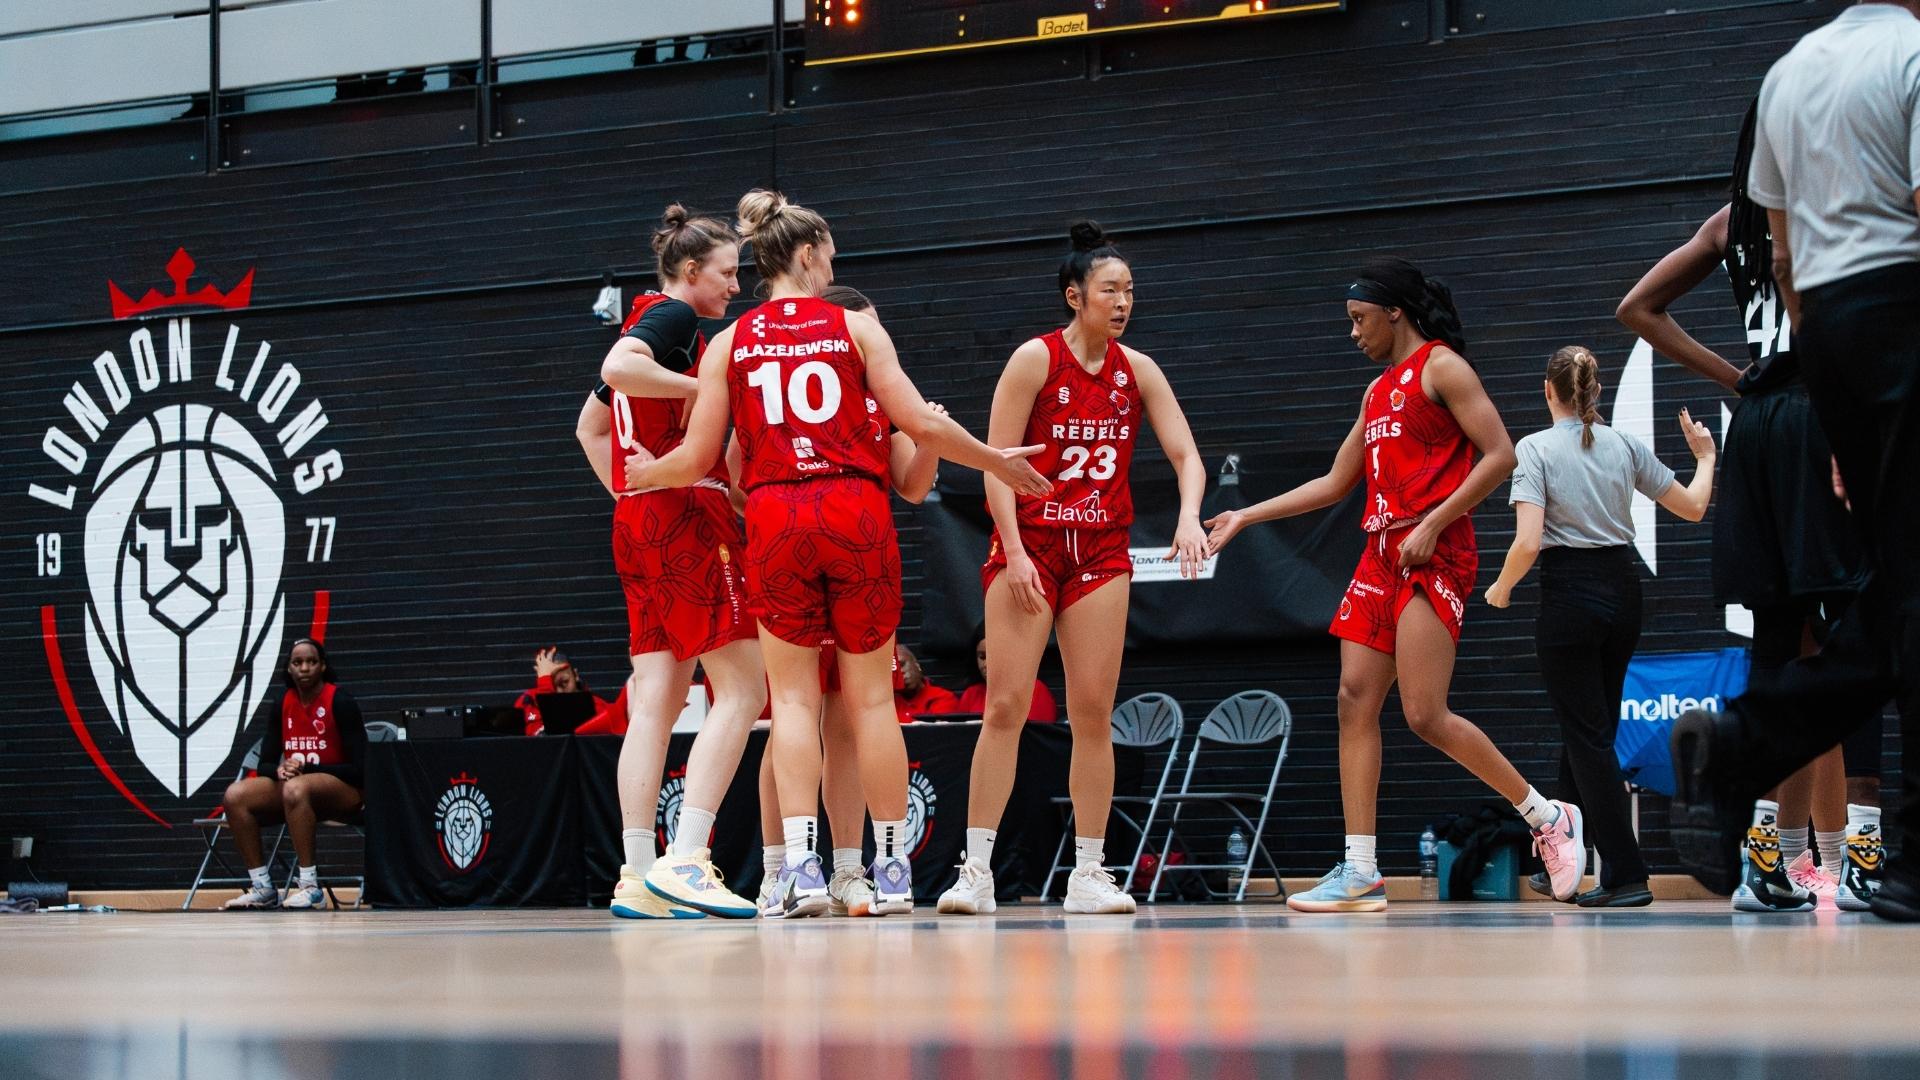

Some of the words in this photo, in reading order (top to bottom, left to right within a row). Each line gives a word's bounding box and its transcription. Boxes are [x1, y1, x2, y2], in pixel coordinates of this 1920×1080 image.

[1042, 20, 1084, 36] Bodet
[734, 339, 849, 363] BLAZEJEWSKI
[748, 361, 842, 425] 10
[28, 316, 192, 511] LONDON
[215, 323, 344, 495] LIONS
[1082, 418, 1096, 426] ARE
[1052, 424, 1130, 441] REBELS
[1365, 421, 1402, 446] EBELS
[796, 460, 830, 471] Oaks
[1058, 445, 1117, 481] 23
[1043, 500, 1108, 523] Elavon
[305, 516, 337, 563] 77
[35, 532, 62, 577] 19
[285, 739, 328, 751] REBELS
[434, 784, 467, 818] LONDON
[469, 785, 493, 818] LIONS
